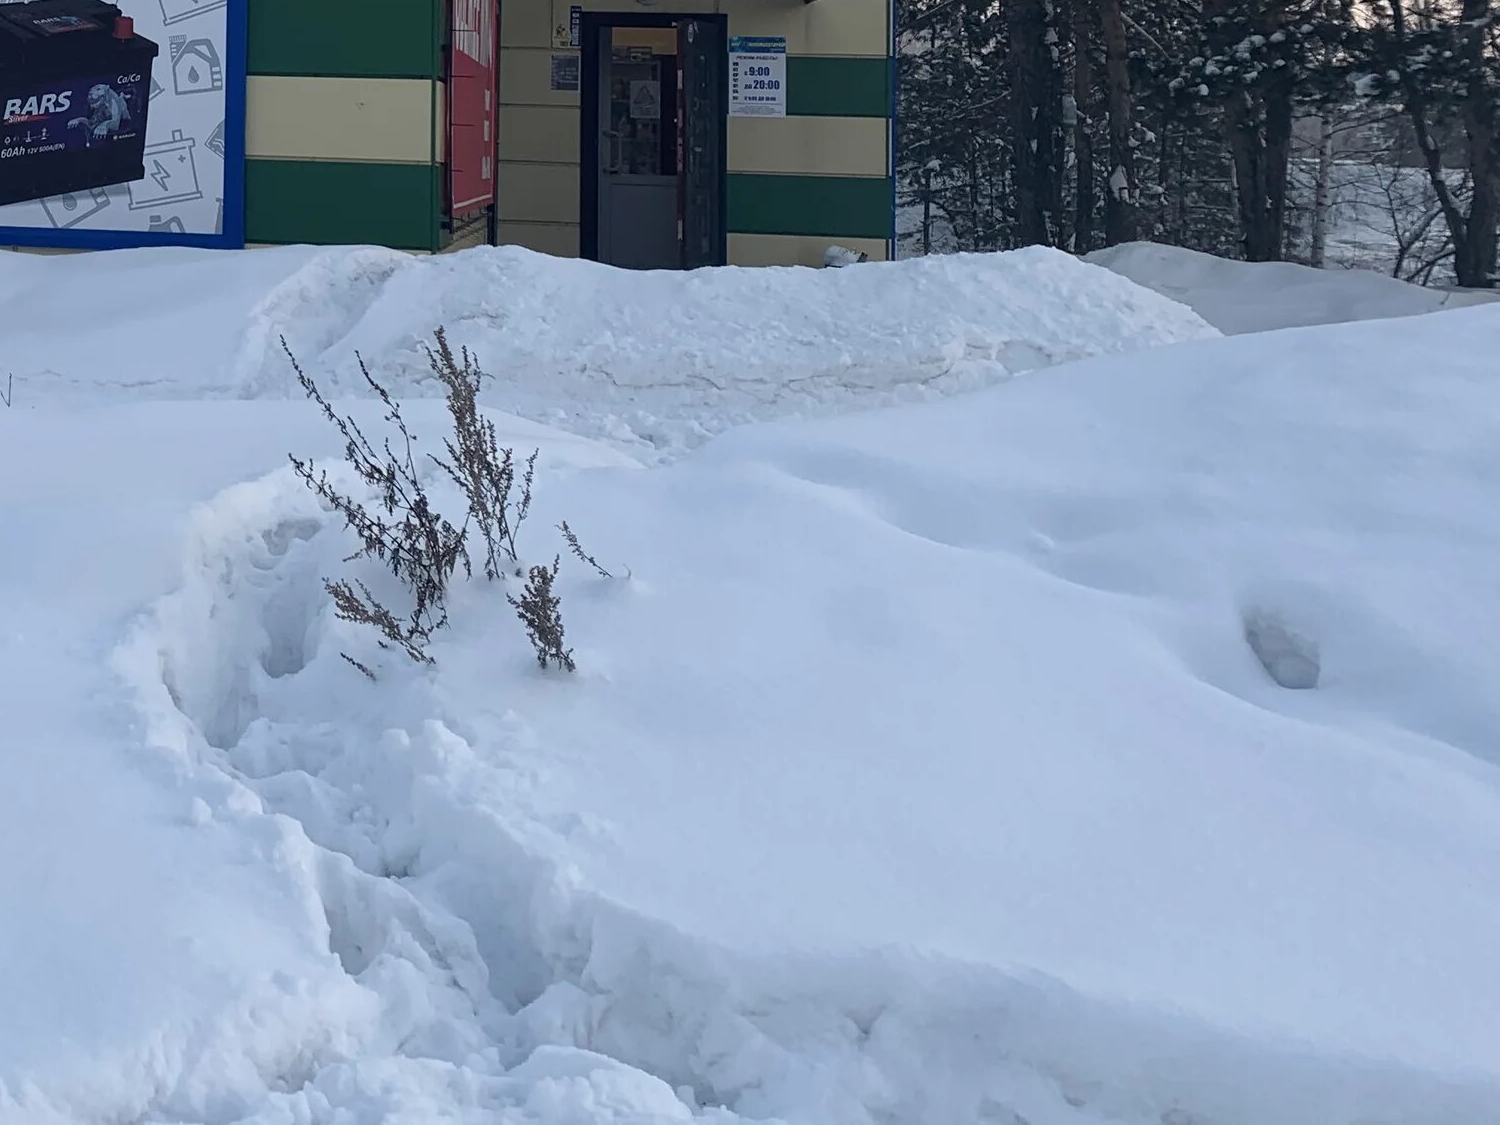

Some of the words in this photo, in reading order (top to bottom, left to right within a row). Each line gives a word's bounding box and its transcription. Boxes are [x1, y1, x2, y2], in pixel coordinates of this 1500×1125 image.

[749, 66, 770, 76] 9:00
[753, 79, 780, 90] 20:00
[3, 91, 73, 120] BARS
[0, 147, 25, 159] 60Ah
